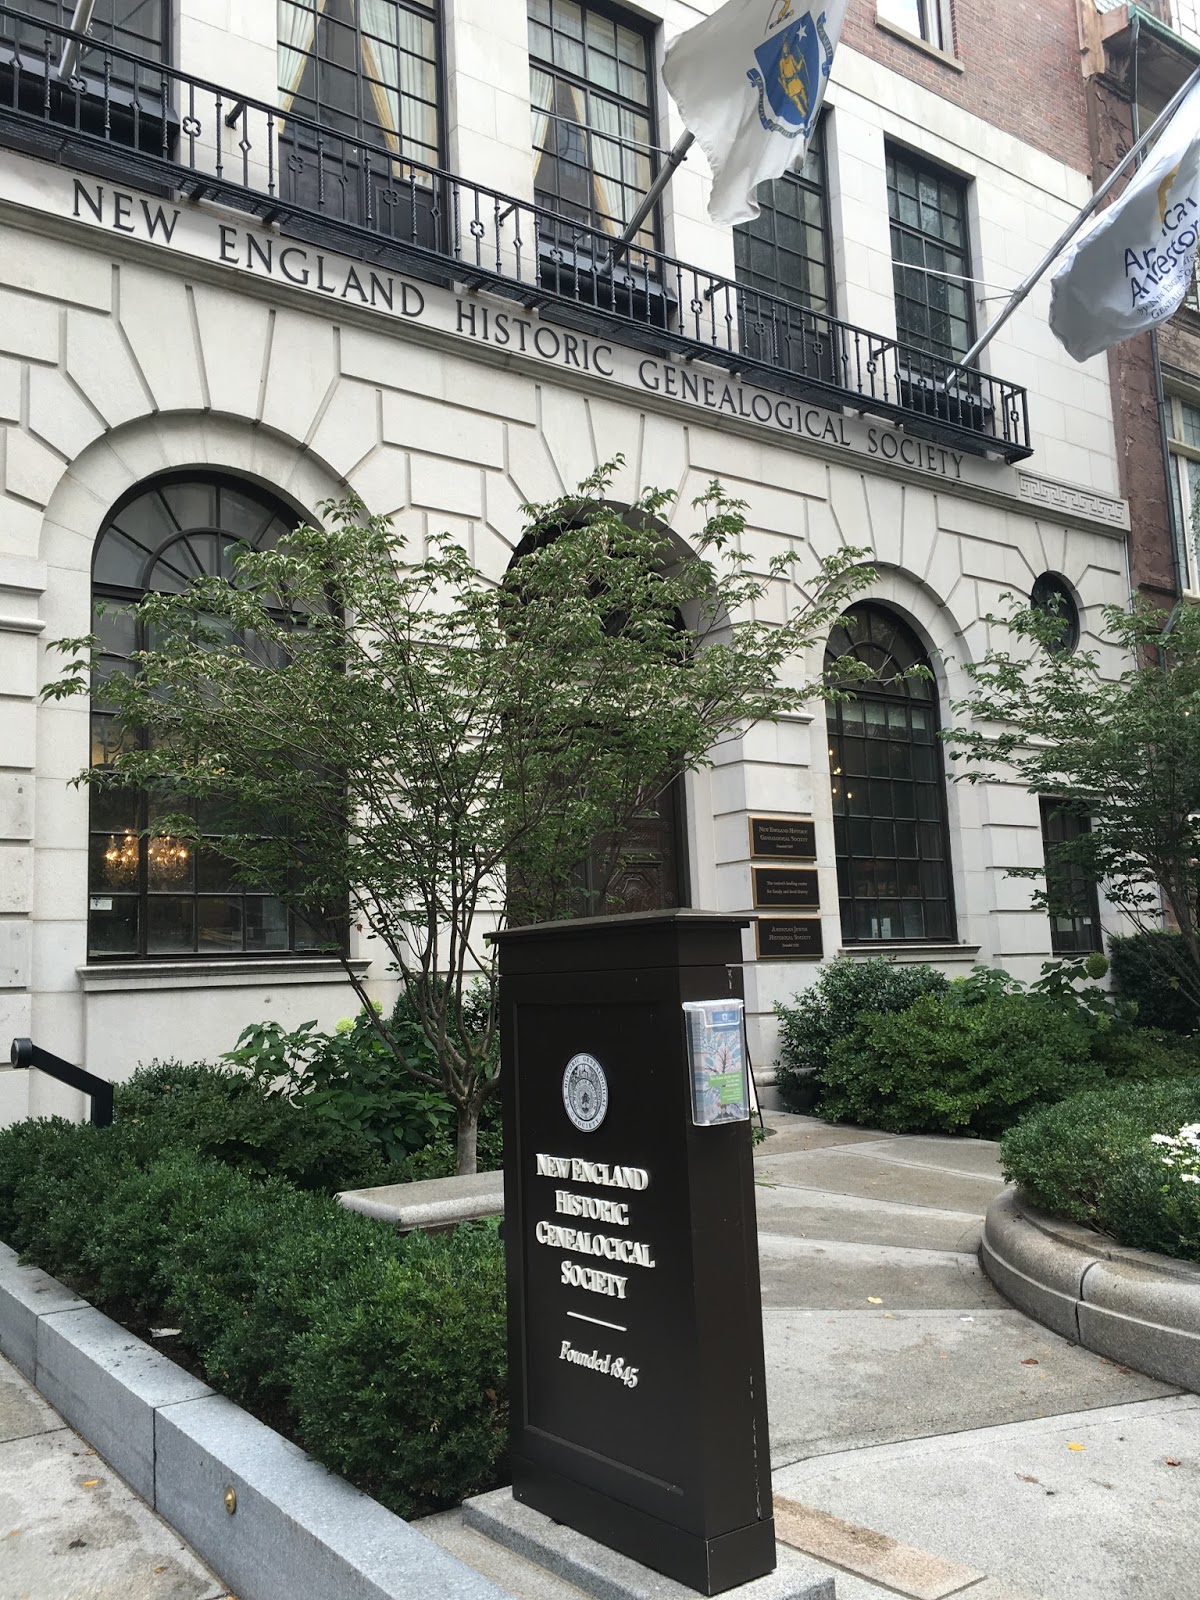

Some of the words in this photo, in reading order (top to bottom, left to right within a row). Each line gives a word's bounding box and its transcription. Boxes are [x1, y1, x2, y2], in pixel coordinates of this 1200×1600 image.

[73, 178, 181, 243] NEW
[218, 224, 425, 317] ENGLAND
[455, 300, 614, 377] HISTORIC
[639, 359, 852, 447] GENEALOGICAL
[867, 428, 964, 478] SOCIETY
[536, 1153, 571, 1179] NEW
[570, 1157, 649, 1191] ENGLAND
[555, 1190, 630, 1226] HISTORIC
[535, 1220, 656, 1268] GENEALOGICAL
[560, 1260, 628, 1299] SOCIETY
[559, 1340, 610, 1374] Founded
[609, 1357, 640, 1389] 1845
